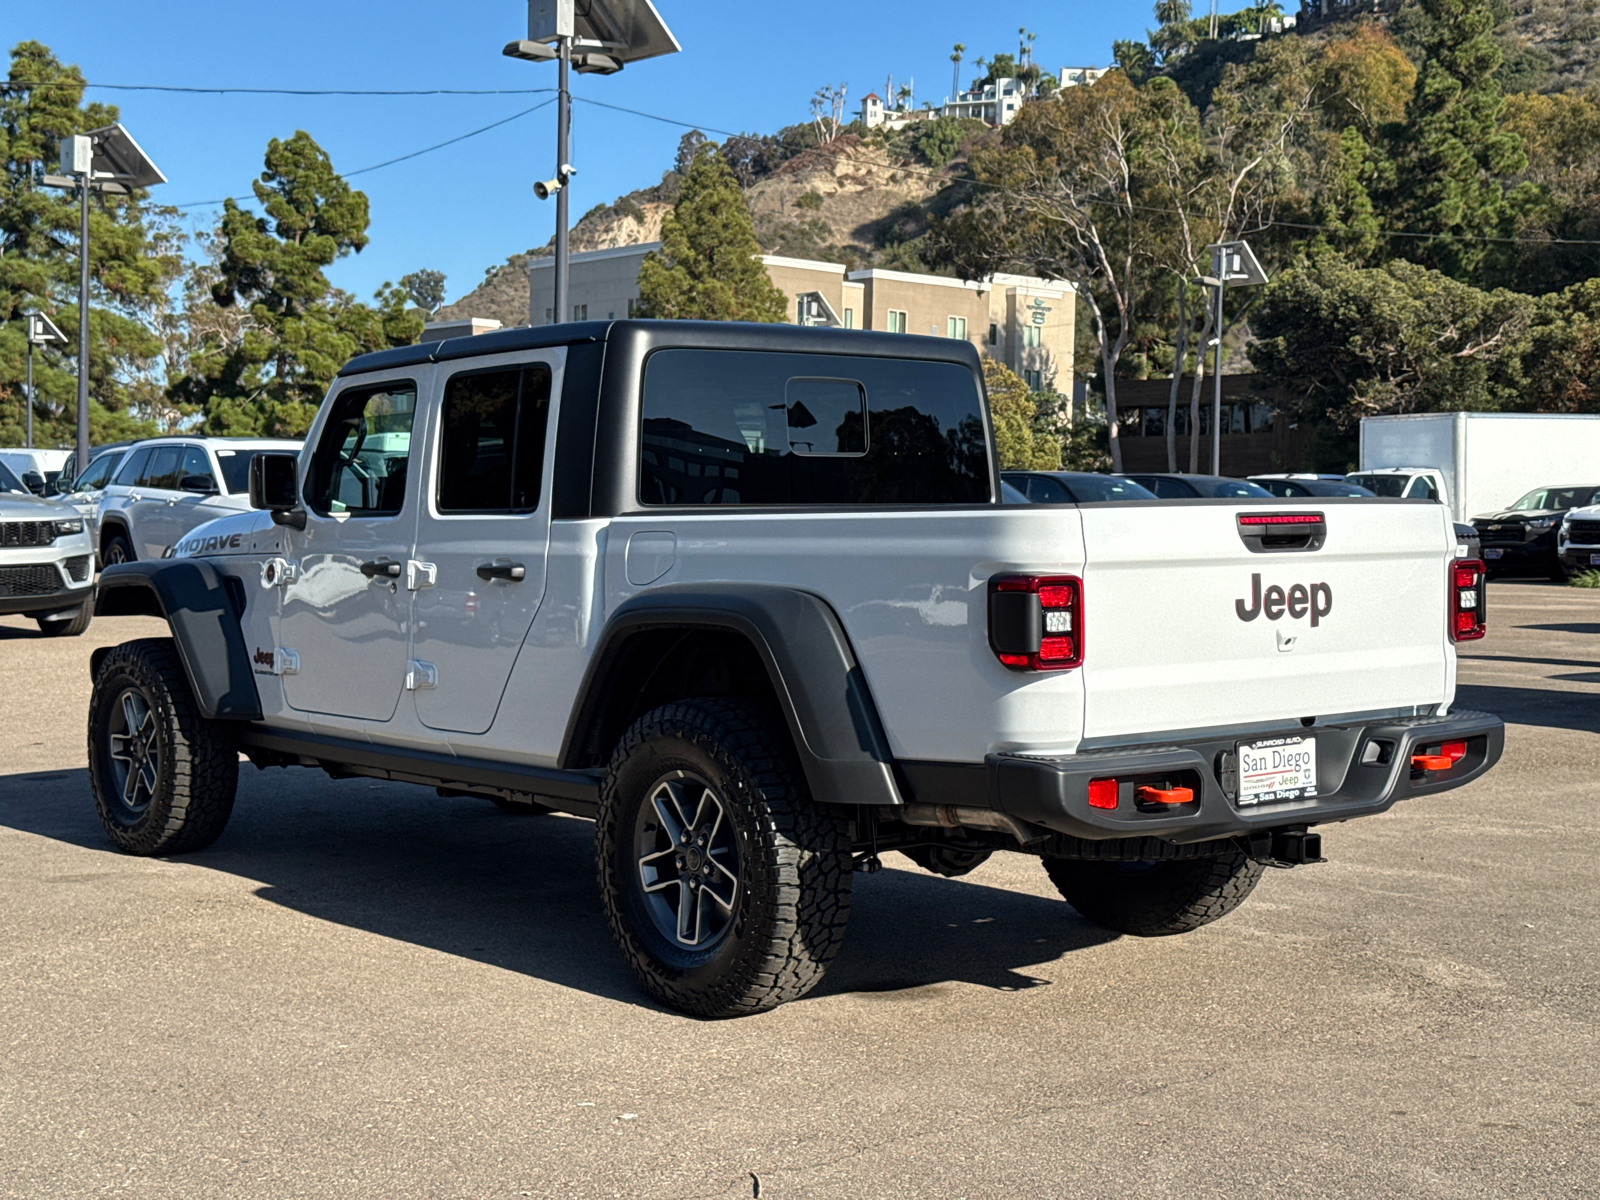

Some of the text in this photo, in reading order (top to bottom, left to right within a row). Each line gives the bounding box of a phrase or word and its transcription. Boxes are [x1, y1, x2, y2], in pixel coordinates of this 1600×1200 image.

[176, 533, 243, 554] MOJAVE
[1235, 573, 1333, 628] Jeep
[253, 646, 275, 669] Jeep
[1285, 736, 1301, 744] AUTO
[1243, 748, 1311, 773] San Diego
[1278, 774, 1299, 786] Jeep
[1259, 793, 1275, 801] San
[1276, 788, 1300, 799] Diego
